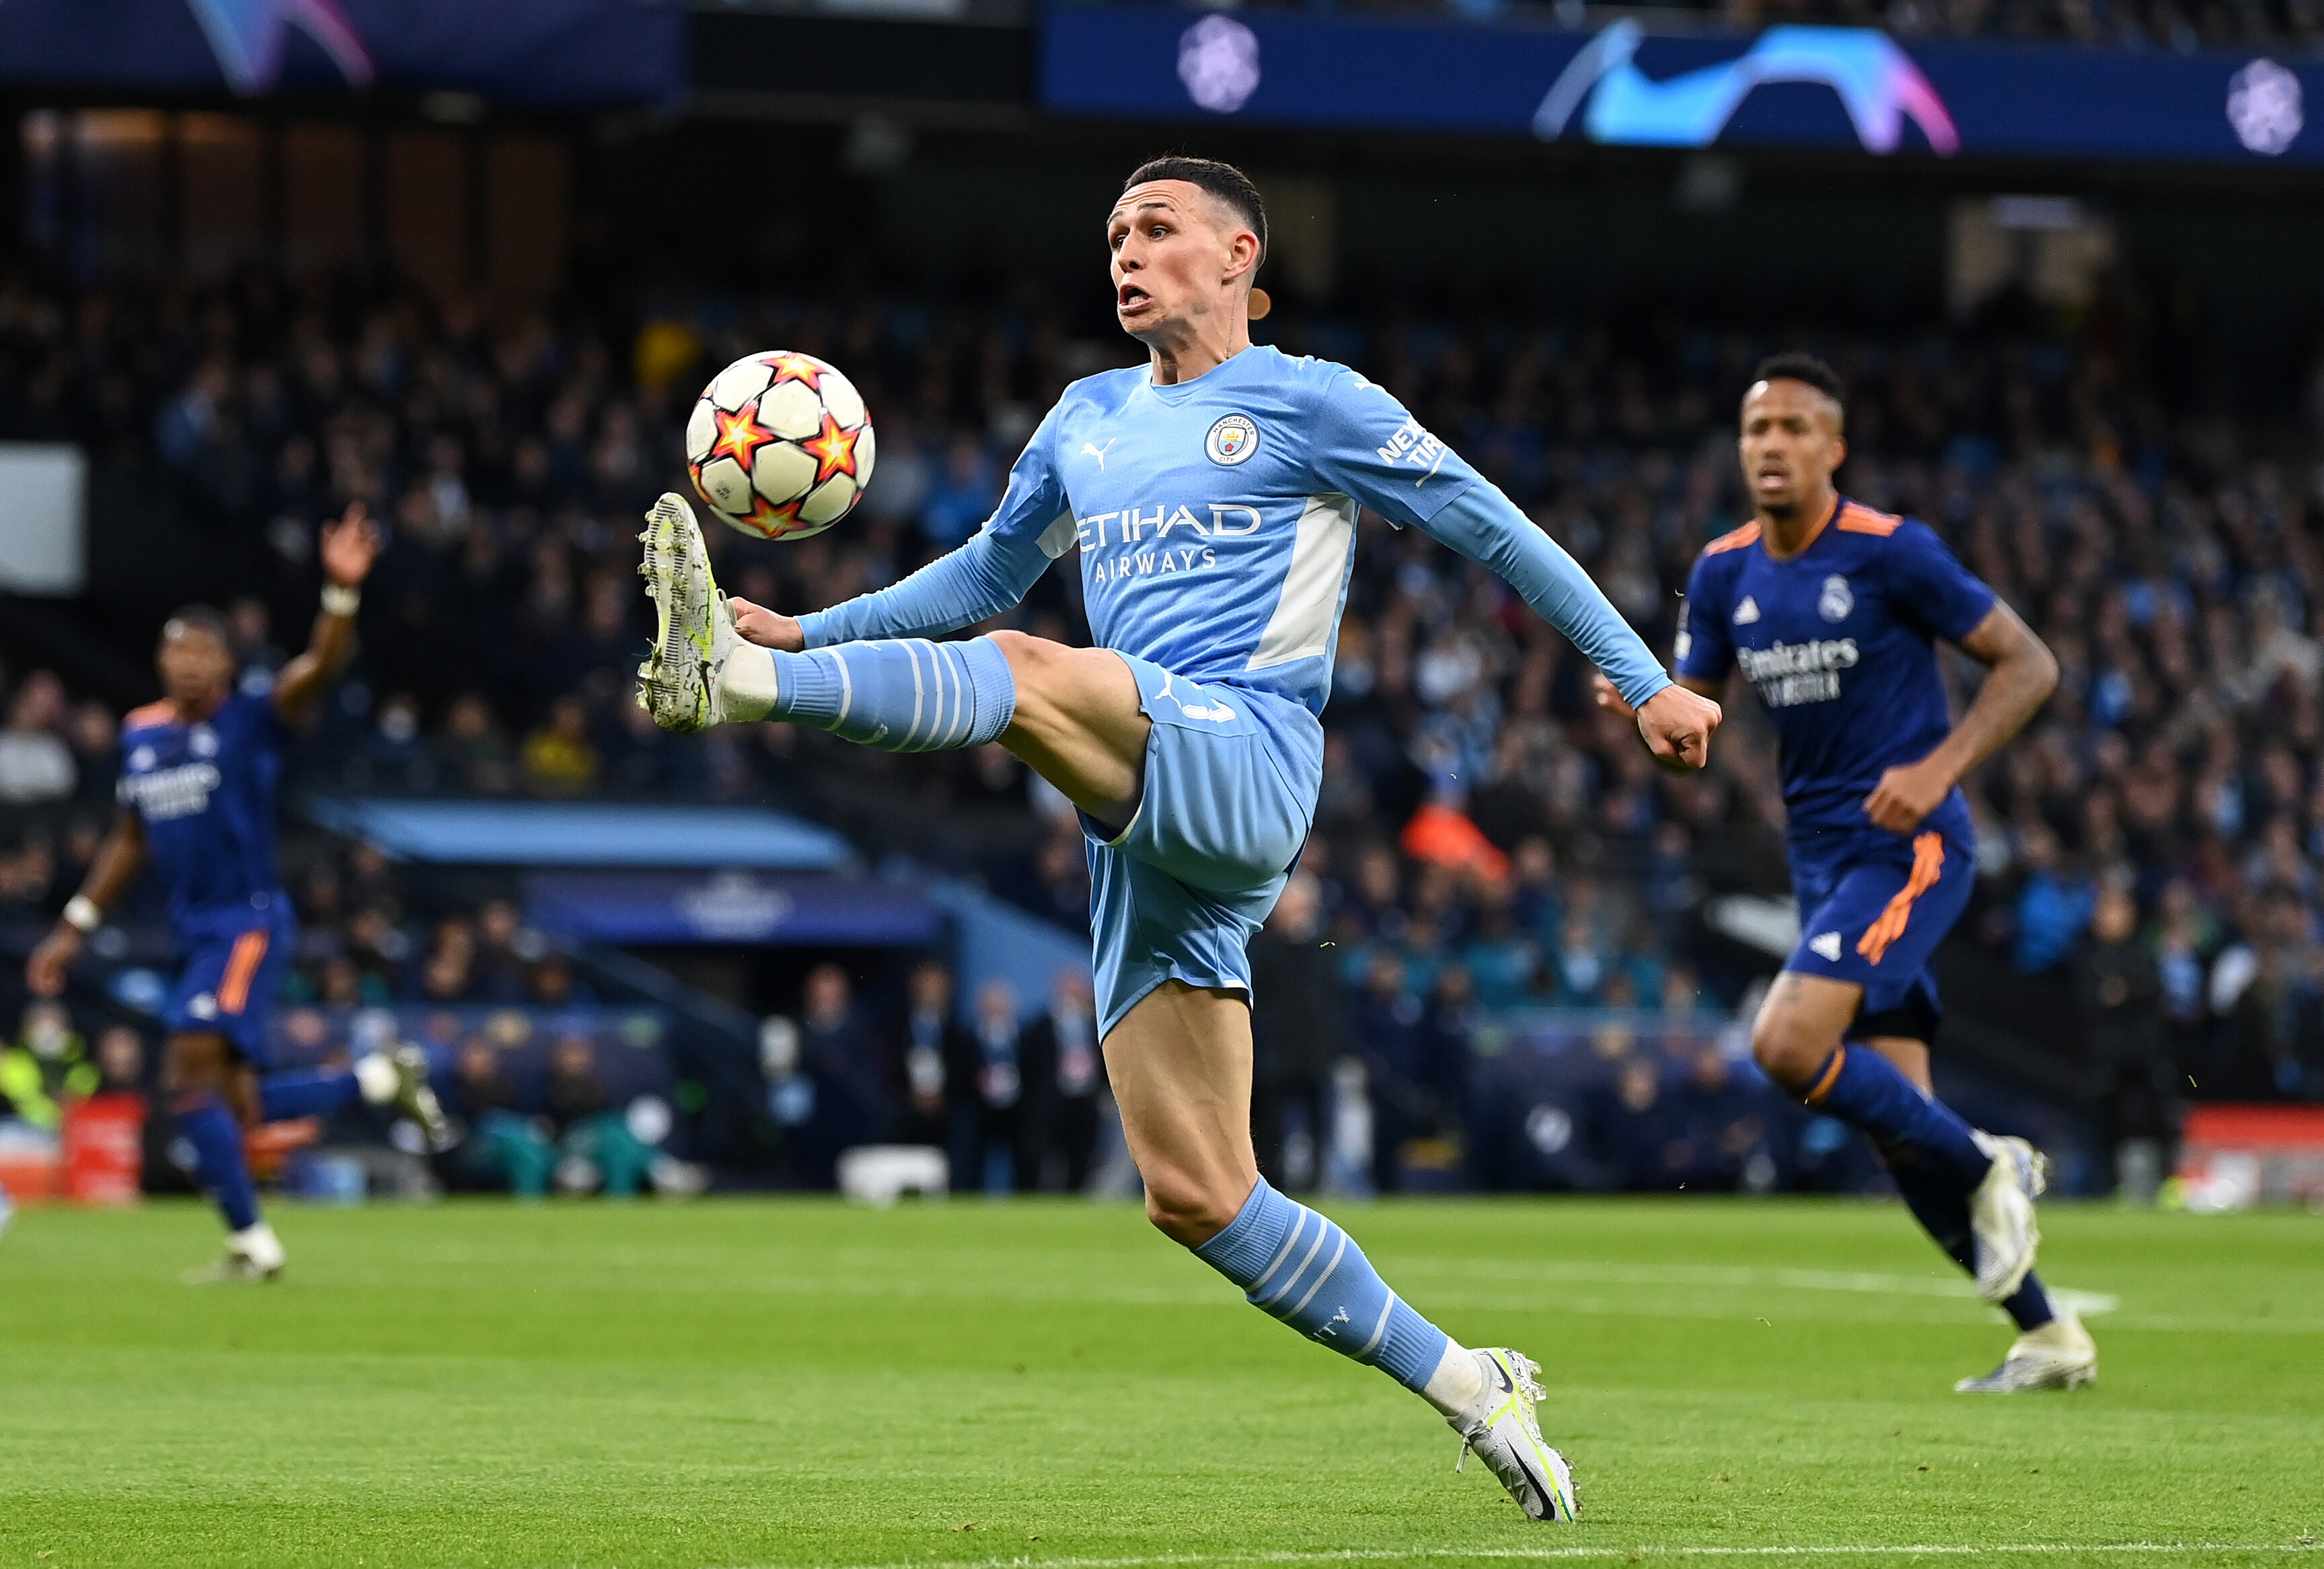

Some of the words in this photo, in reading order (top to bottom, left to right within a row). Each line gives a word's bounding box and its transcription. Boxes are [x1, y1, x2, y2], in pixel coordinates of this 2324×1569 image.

[1213, 418, 1254, 435] MANCHESTER
[1377, 415, 1427, 465] NEX
[1406, 432, 1446, 468] TIR
[1076, 503, 1261, 552] ETIHAD
[1095, 548, 1216, 583] AIRWAYS
[1309, 1306, 1351, 1341] ITY
